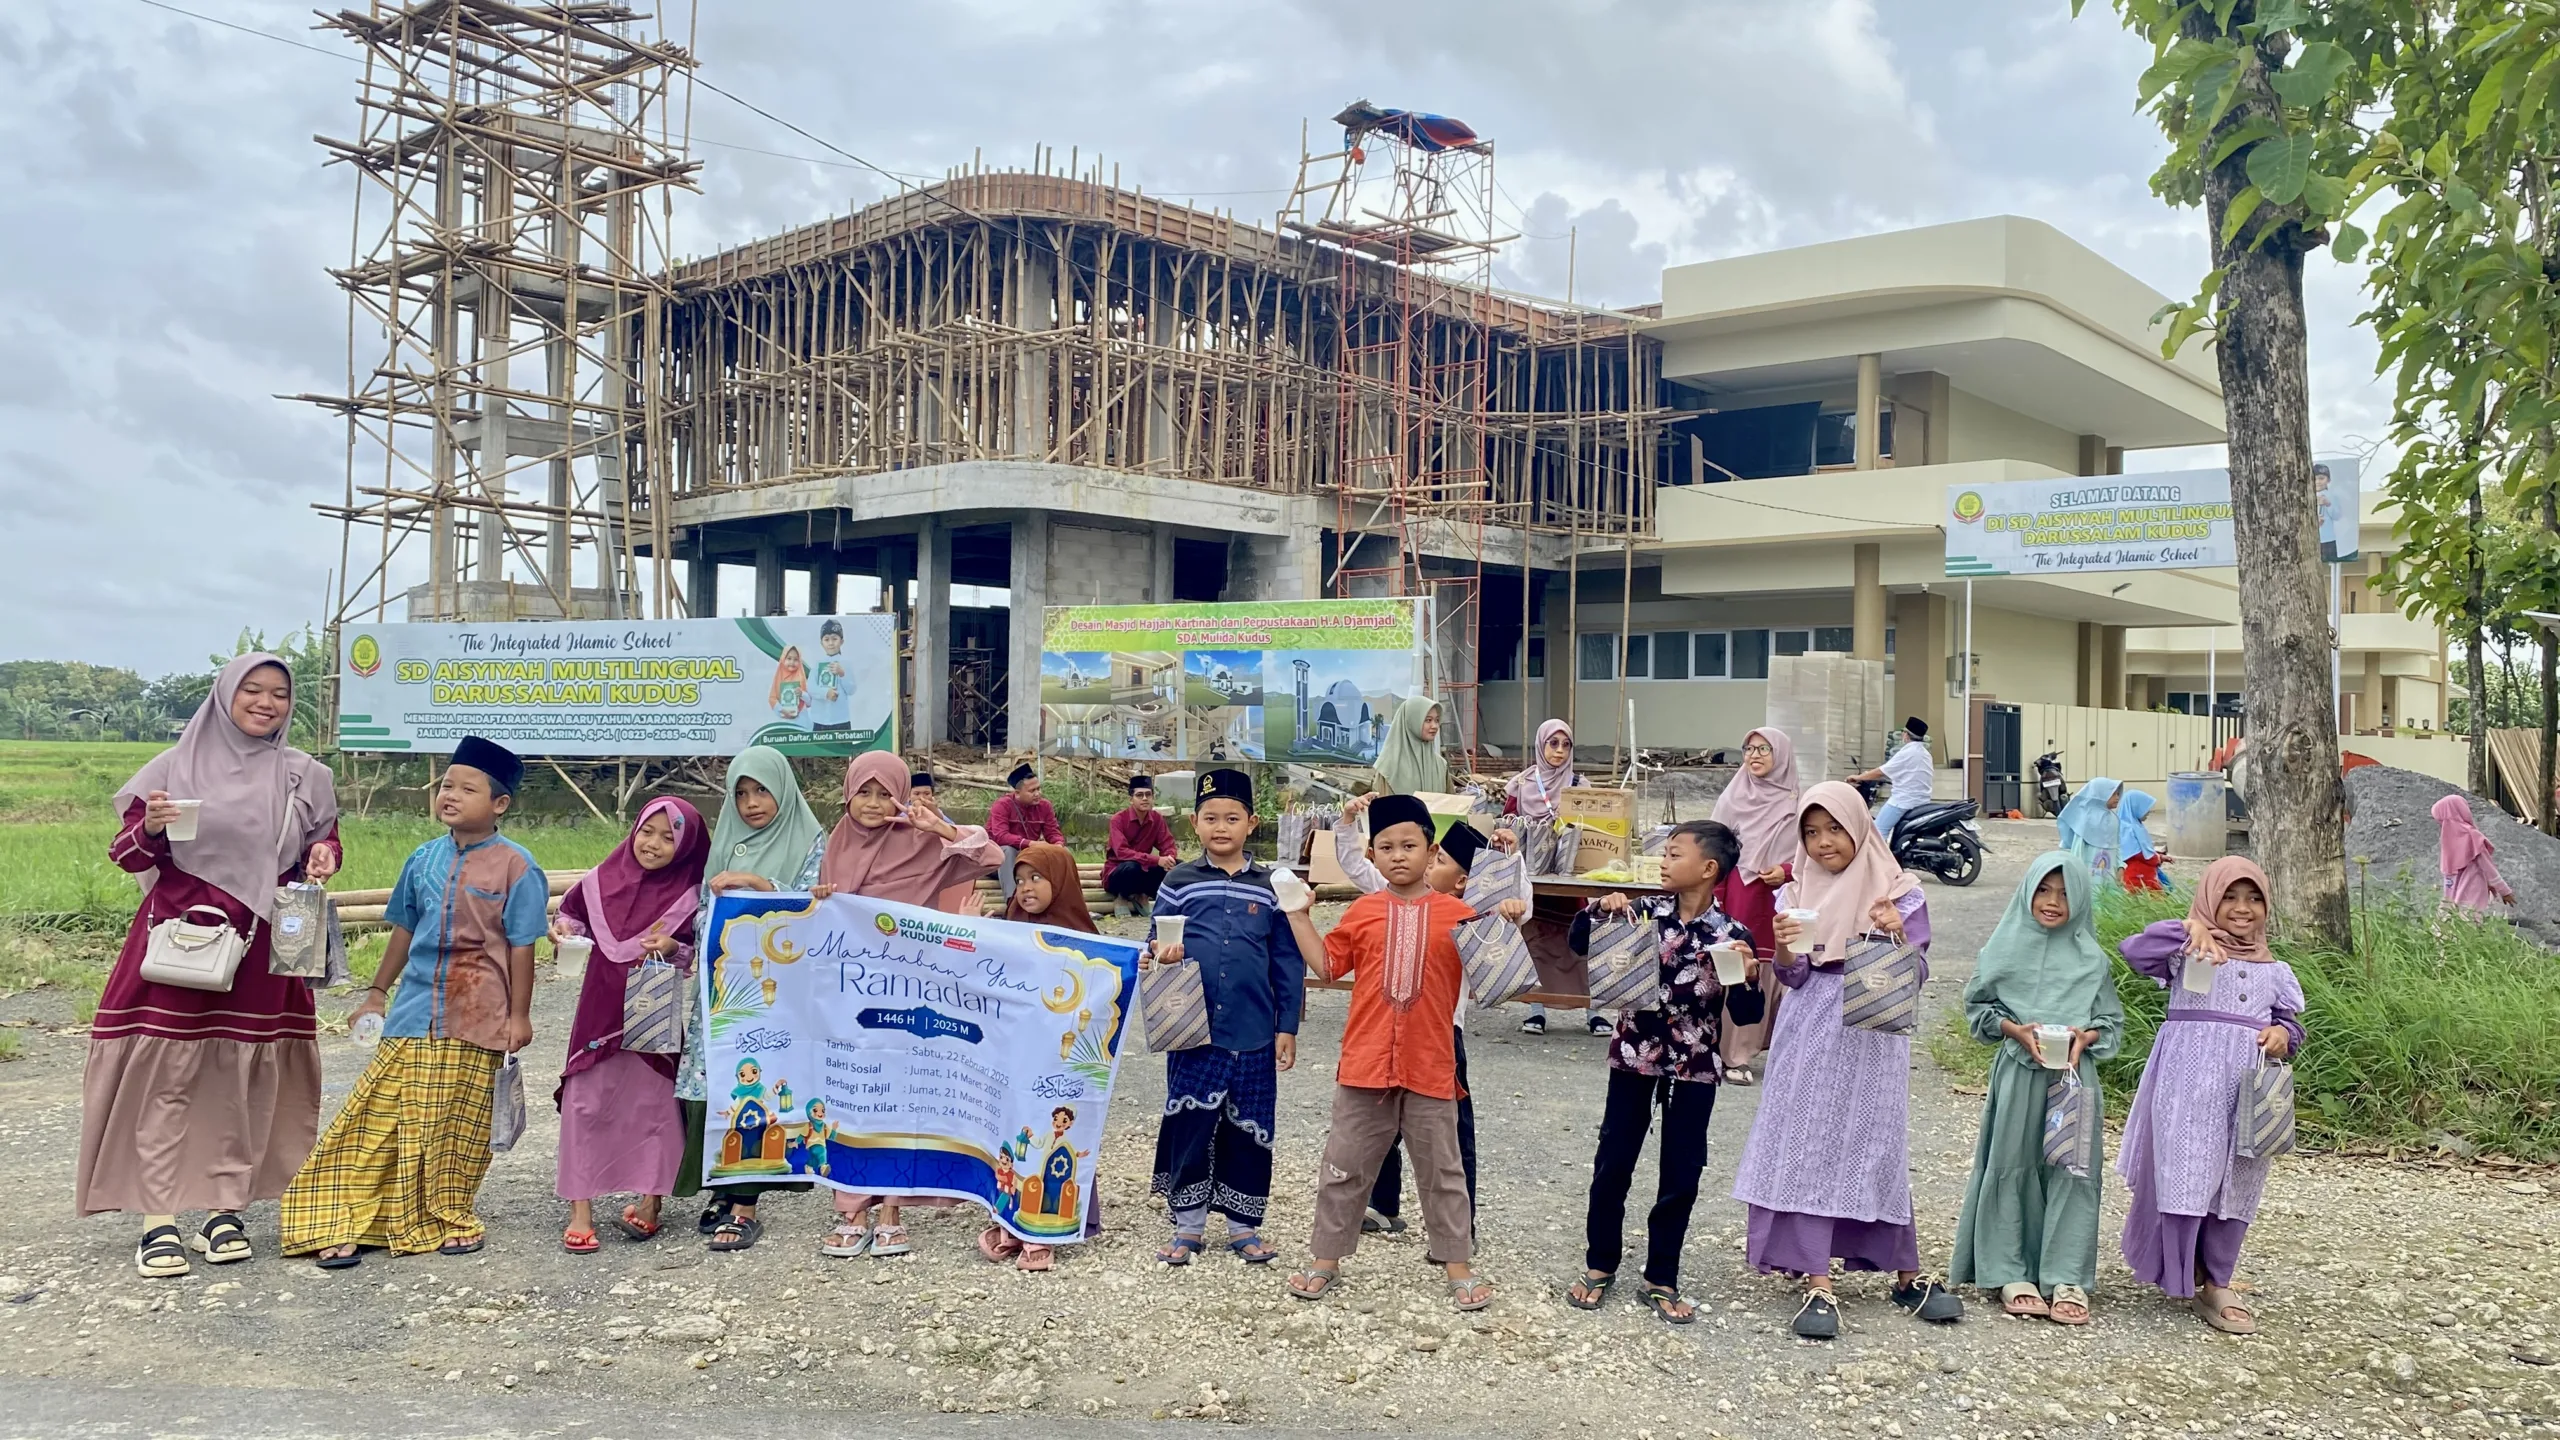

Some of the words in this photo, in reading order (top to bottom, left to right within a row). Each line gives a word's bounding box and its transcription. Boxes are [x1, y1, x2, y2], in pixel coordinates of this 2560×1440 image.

[2050, 487, 2118, 508] SELAMAT
[2121, 486, 2181, 501] DATANG
[1985, 516, 2004, 531] DI
[2008, 514, 2032, 530] SD
[2035, 509, 2113, 528] AISYIYAH
[2118, 503, 2236, 523] MULTILINGUA
[2022, 525, 2141, 545] DARUSSALAM
[2146, 521, 2209, 540] KUDUS
[2032, 552, 2052, 568] The
[2057, 550, 2112, 569] Integrated
[2115, 549, 2155, 565] Islamic
[2160, 547, 2198, 563] School
[1070, 619, 1101, 630] Desain
[1105, 618, 1136, 632] Masjid
[1139, 618, 1171, 633] Hajjah
[1174, 616, 1218, 630] Kartinah
[1221, 616, 1240, 629] dan
[1243, 615, 1317, 631] Perpustakaan
[1320, 614, 1340, 627] H.A
[1343, 613, 1397, 630] Djamjadi
[459, 632, 485, 653] The
[491, 632, 561, 656] Integrated
[566, 631, 617, 652] Islamic
[622, 631, 673, 651] School
[1176, 632, 1199, 645] SDA
[1201, 631, 1236, 644] Mulida
[1237, 631, 1272, 644] Kudus
[396, 661, 430, 681] SD
[433, 660, 546, 681] AISYIYAH
[552, 658, 741, 681] MULTILINGUAL
[432, 683, 602, 704] DARUSSALAM
[610, 682, 699, 704] KUDUS
[404, 713, 455, 725] MENERIMA
[456, 713, 529, 725] PENDAFTARAN
[530, 713, 564, 725] SISWA
[565, 713, 595, 725] BARU
[596, 713, 632, 725] TAHUN
[633, 713, 677, 725] AJARAN
[678, 712, 732, 726] 2025/2026
[417, 727, 448, 739] JALUR
[449, 727, 481, 739] CEPAT
[482, 728, 510, 740] PPDB
[511, 728, 541, 740] USTH.
[541, 728, 586, 741] AMRINA,
[763, 735, 787, 744] Buruan
[788, 733, 812, 743] Daftar,
[813, 732, 833, 741] Kuota
[834, 730, 872, 740] Terbatas!!!
[899, 918, 924, 931] SDA
[926, 922, 977, 939] MULIDA
[900, 929, 943, 945] KUDUS
[807, 930, 968, 979] Marhaban
[976, 958, 1040, 993] Yaa
[840, 962, 1002, 1019] Ramadan
[877, 1012, 904, 1024] 1446
[907, 1013, 915, 1025] H
[932, 1018, 958, 1032] 2025
[960, 1024, 969, 1036] M
[826, 1039, 855, 1053] Tarhib
[912, 1046, 943, 1060] Sabtu,
[946, 1050, 959, 1063] 22
[990, 1068, 1009, 1087] 2025
[826, 1056, 848, 1071] Bakti
[850, 1062, 882, 1074] Sosial
[909, 1065, 943, 1080] Jumat,
[946, 1068, 958, 1081] 14
[960, 1072, 982, 1090] Maret
[984, 1083, 1002, 1101] 2025
[825, 1075, 859, 1095] Berbagi
[861, 1082, 891, 1096] Takjil
[908, 1084, 942, 1098] Jumat,
[944, 1088, 957, 1099] 21
[959, 1090, 983, 1109] Maret
[984, 1101, 1002, 1119] 2025
[825, 1094, 870, 1113] Pesantren
[873, 1101, 898, 1113] Kilat
[908, 1102, 939, 1116] Senin,
[941, 1105, 955, 1117] 24
[958, 1110, 983, 1127] Maret
[983, 1120, 1001, 1137] 2025
